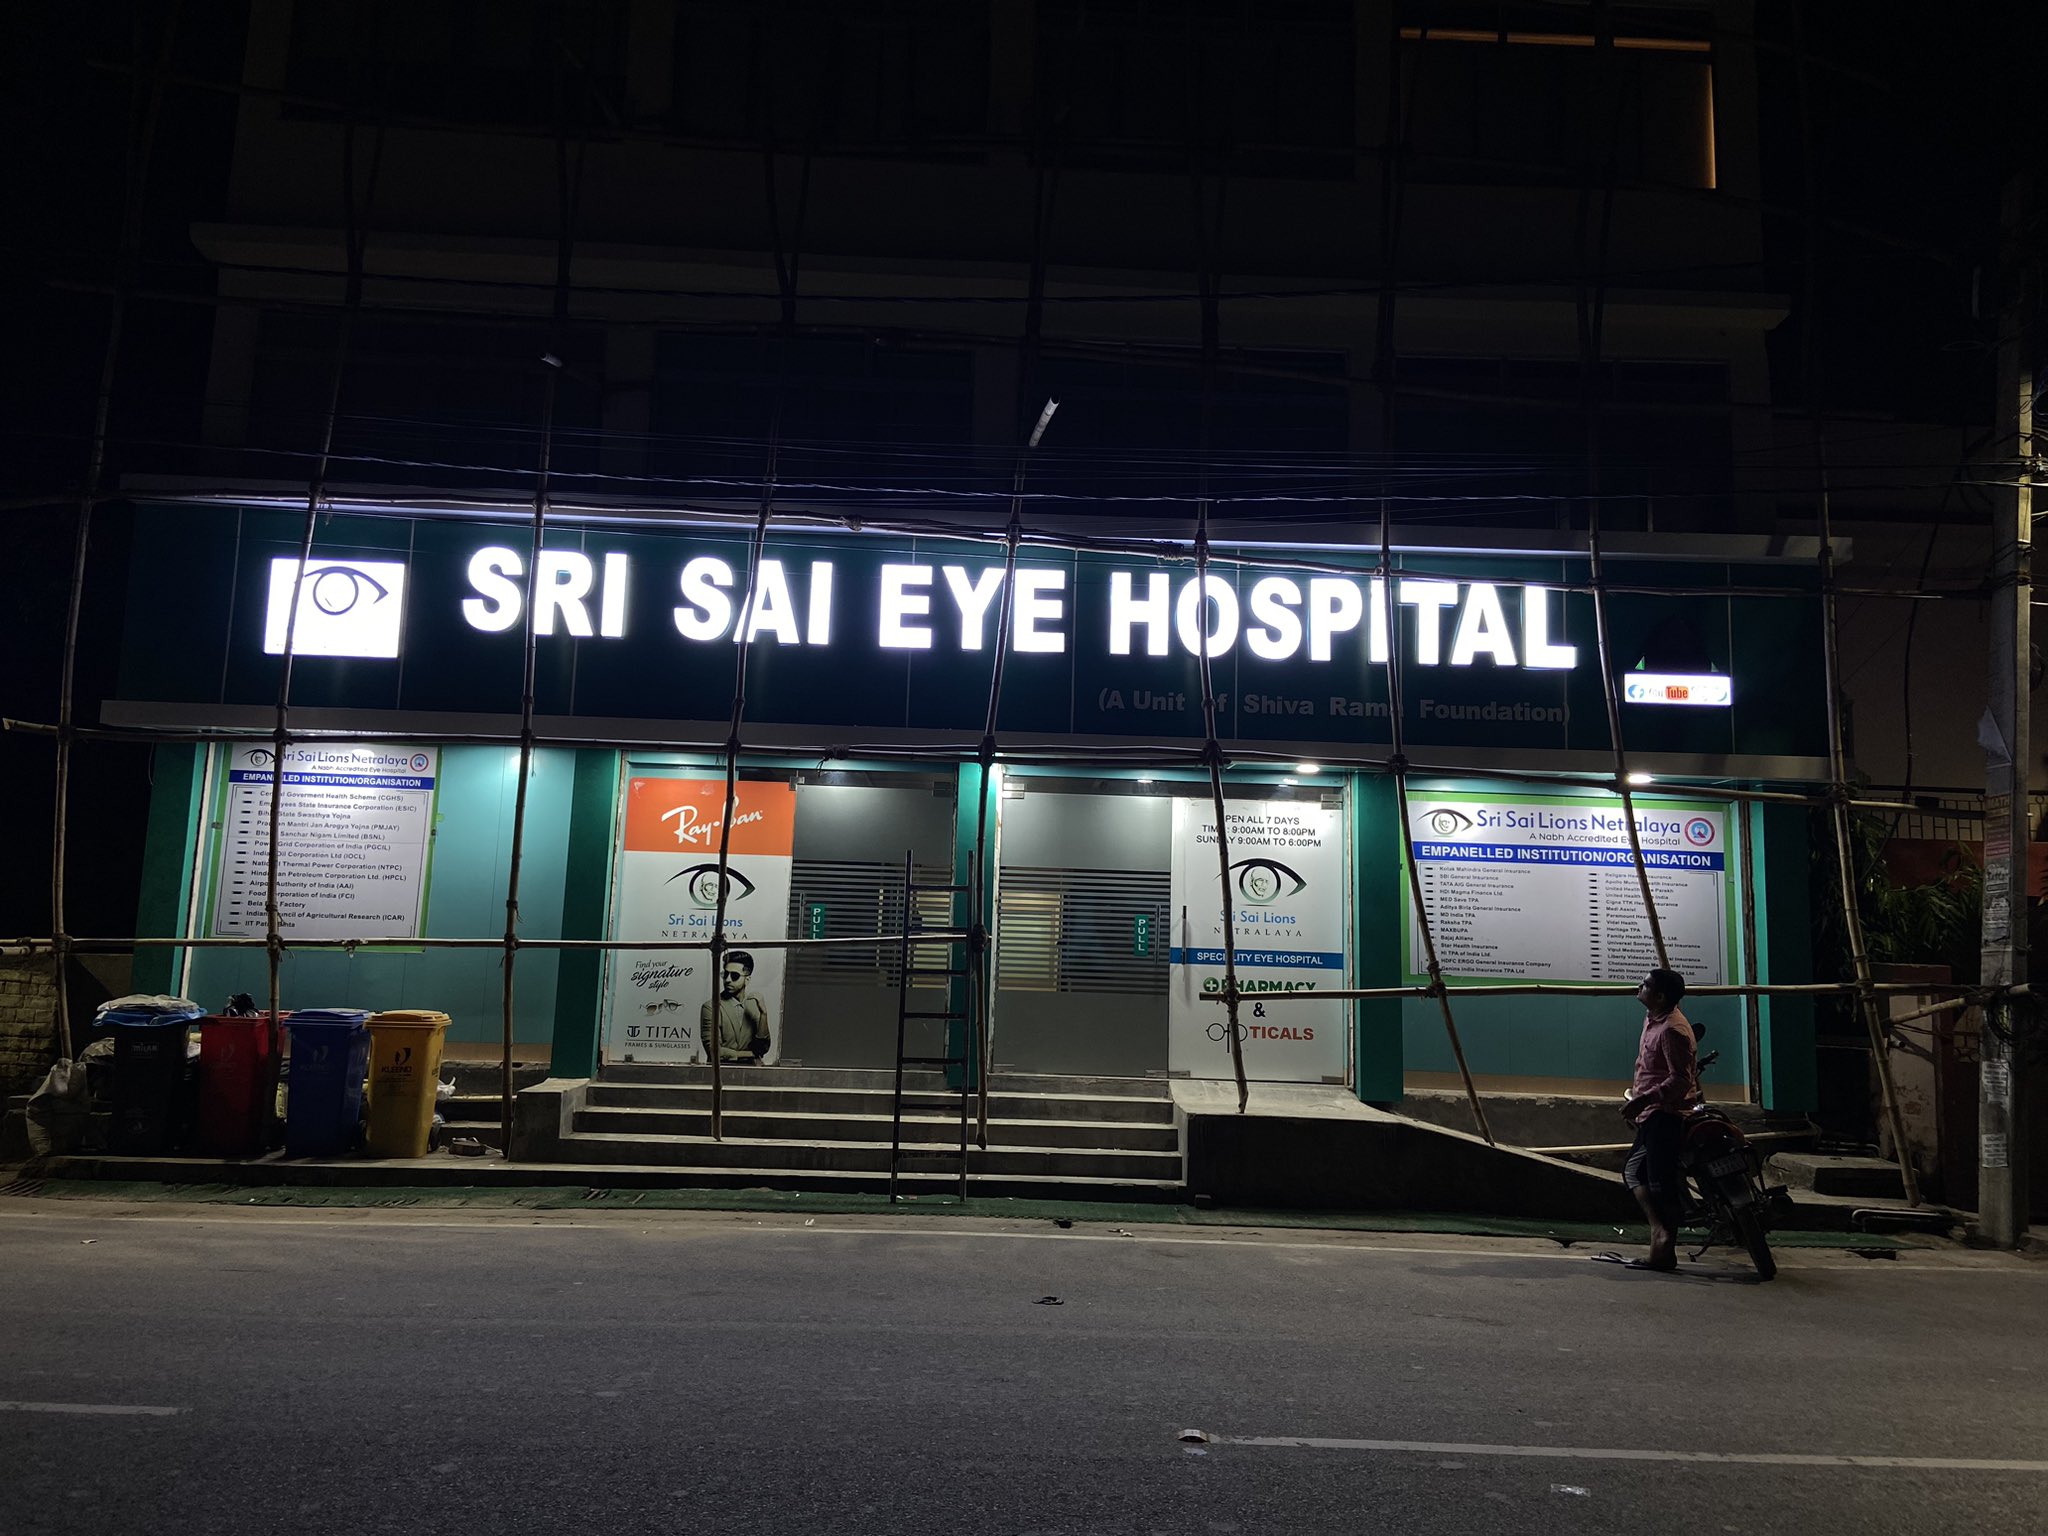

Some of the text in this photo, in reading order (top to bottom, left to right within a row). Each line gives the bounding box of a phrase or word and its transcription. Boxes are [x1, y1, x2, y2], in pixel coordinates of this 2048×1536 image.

[463, 547, 1577, 669] SRI SAI EYE HOSPITAL
[1098, 688, 1125, 711] (A
[1133, 690, 1185, 711] Unit
[1243, 694, 1314, 715] Shiva
[297, 750, 316, 762] Sai
[318, 751, 350, 763] Lions
[352, 753, 408, 767] Netralaya
[243, 773, 300, 782] EMPANLED
[1225, 815, 1300, 825] PEN ALL 7 DAYS
[1477, 809, 1501, 827] Sri
[1506, 811, 1534, 828] Sai
[1538, 812, 1587, 831] Lions
[1202, 825, 1219, 833] TIM
[1231, 826, 1265, 835] 9:00AM
[1268, 827, 1281, 835] TO
[1282, 827, 1316, 836] 8:00PM
[1196, 835, 1322, 847] SUNY 9:00AM TO 6:00PM
[1539, 832, 1565, 841] Nabh
[1567, 834, 1618, 843] Accredited
[1621, 835, 1632, 845] Ey
[1641, 837, 1681, 846] Hospital
[1422, 845, 1513, 859] EMPANELLED
[668, 913, 743, 928] Sri Sai Lons
[1220, 911, 1296, 924] Si Sai Lions
[661, 930, 748, 940] NETRAAYA
[1137, 918, 1146, 951] PULL
[1214, 927, 1302, 937] NTRALAYA
[635, 960, 668, 970] Find your
[1197, 952, 1323, 964] SPECIITY EYE HOSPITAL
[630, 964, 694, 987] signature
[648, 979, 670, 992] style
[1253, 1002, 1266, 1017] &
[645, 1025, 691, 1039] TITAN
